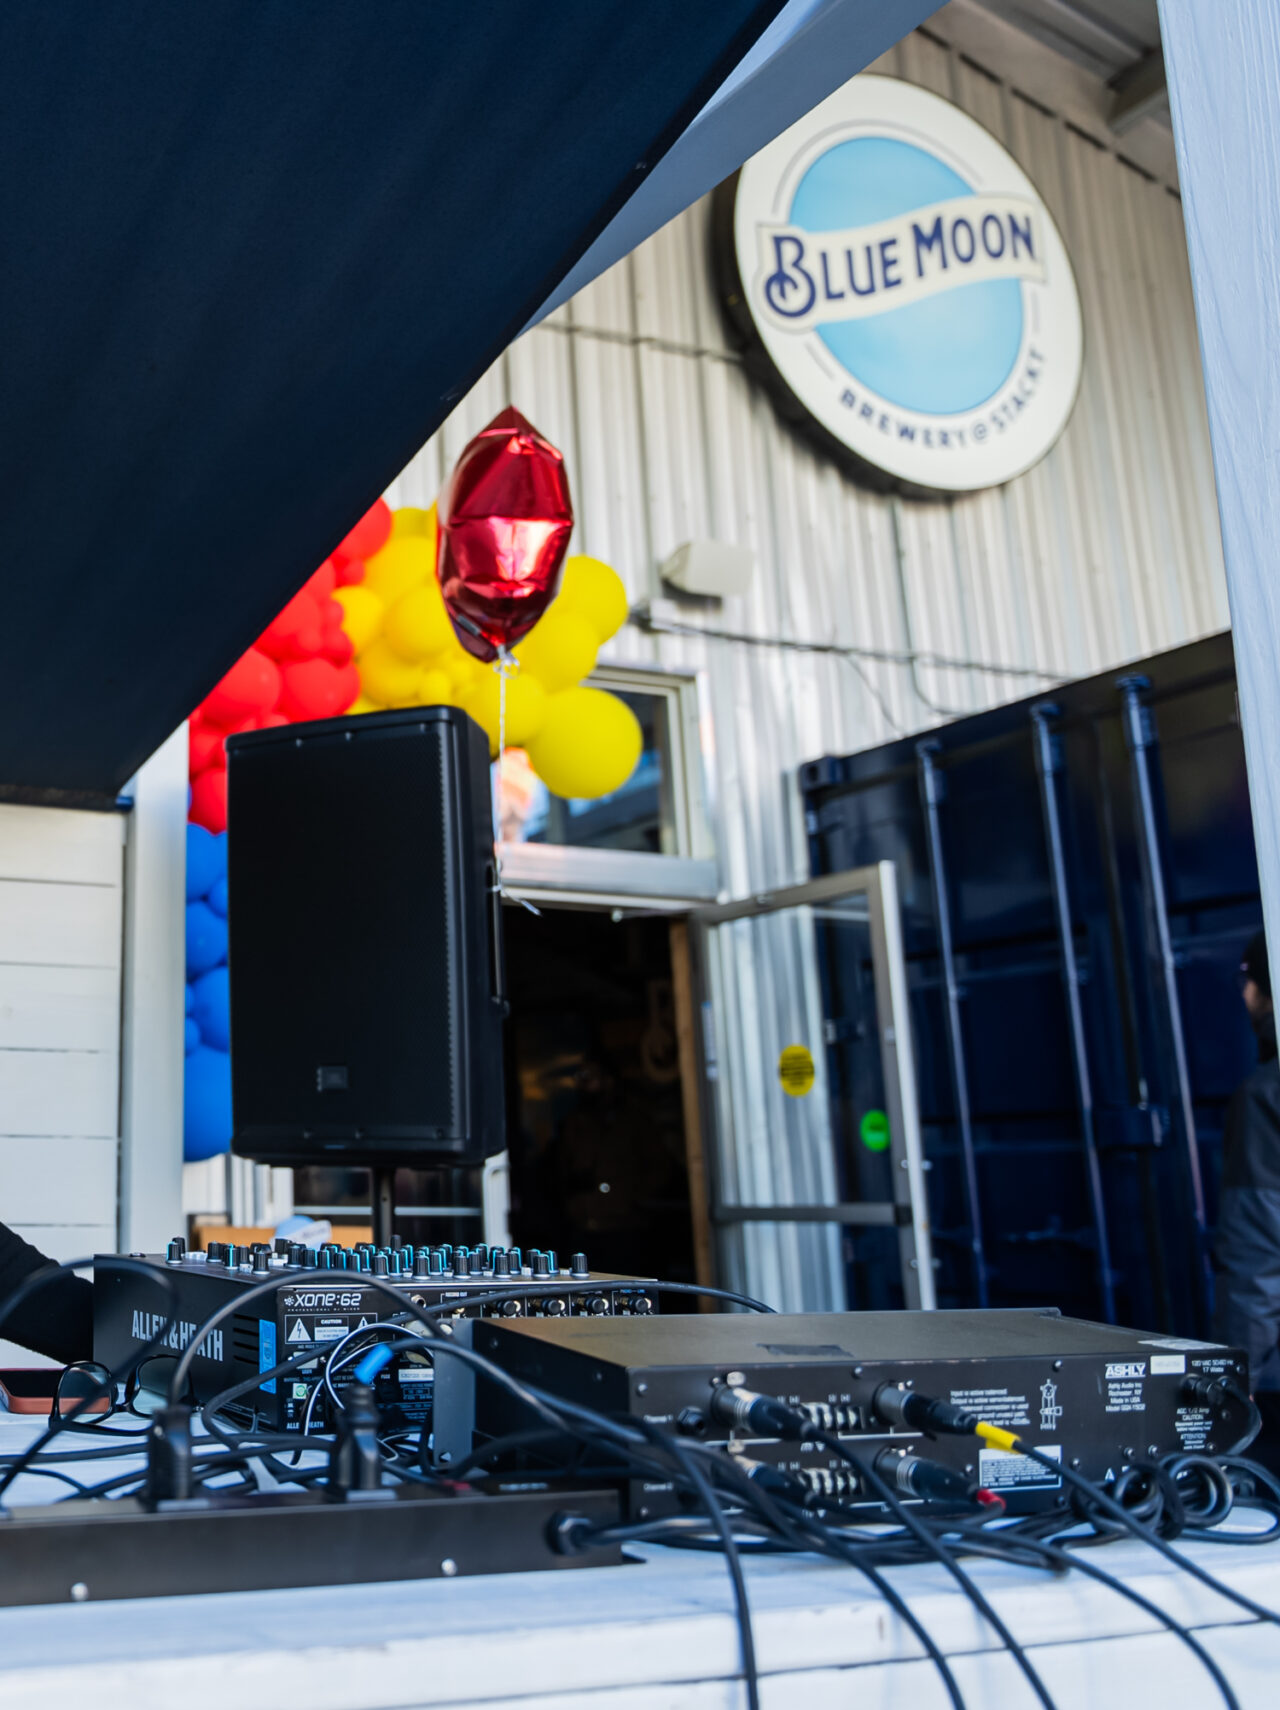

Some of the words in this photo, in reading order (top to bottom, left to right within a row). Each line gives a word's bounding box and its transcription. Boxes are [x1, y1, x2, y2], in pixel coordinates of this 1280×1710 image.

[765, 235, 902, 319] BLUE
[911, 213, 1036, 278] MOON
[1105, 1364, 1146, 1377] ASHLY
